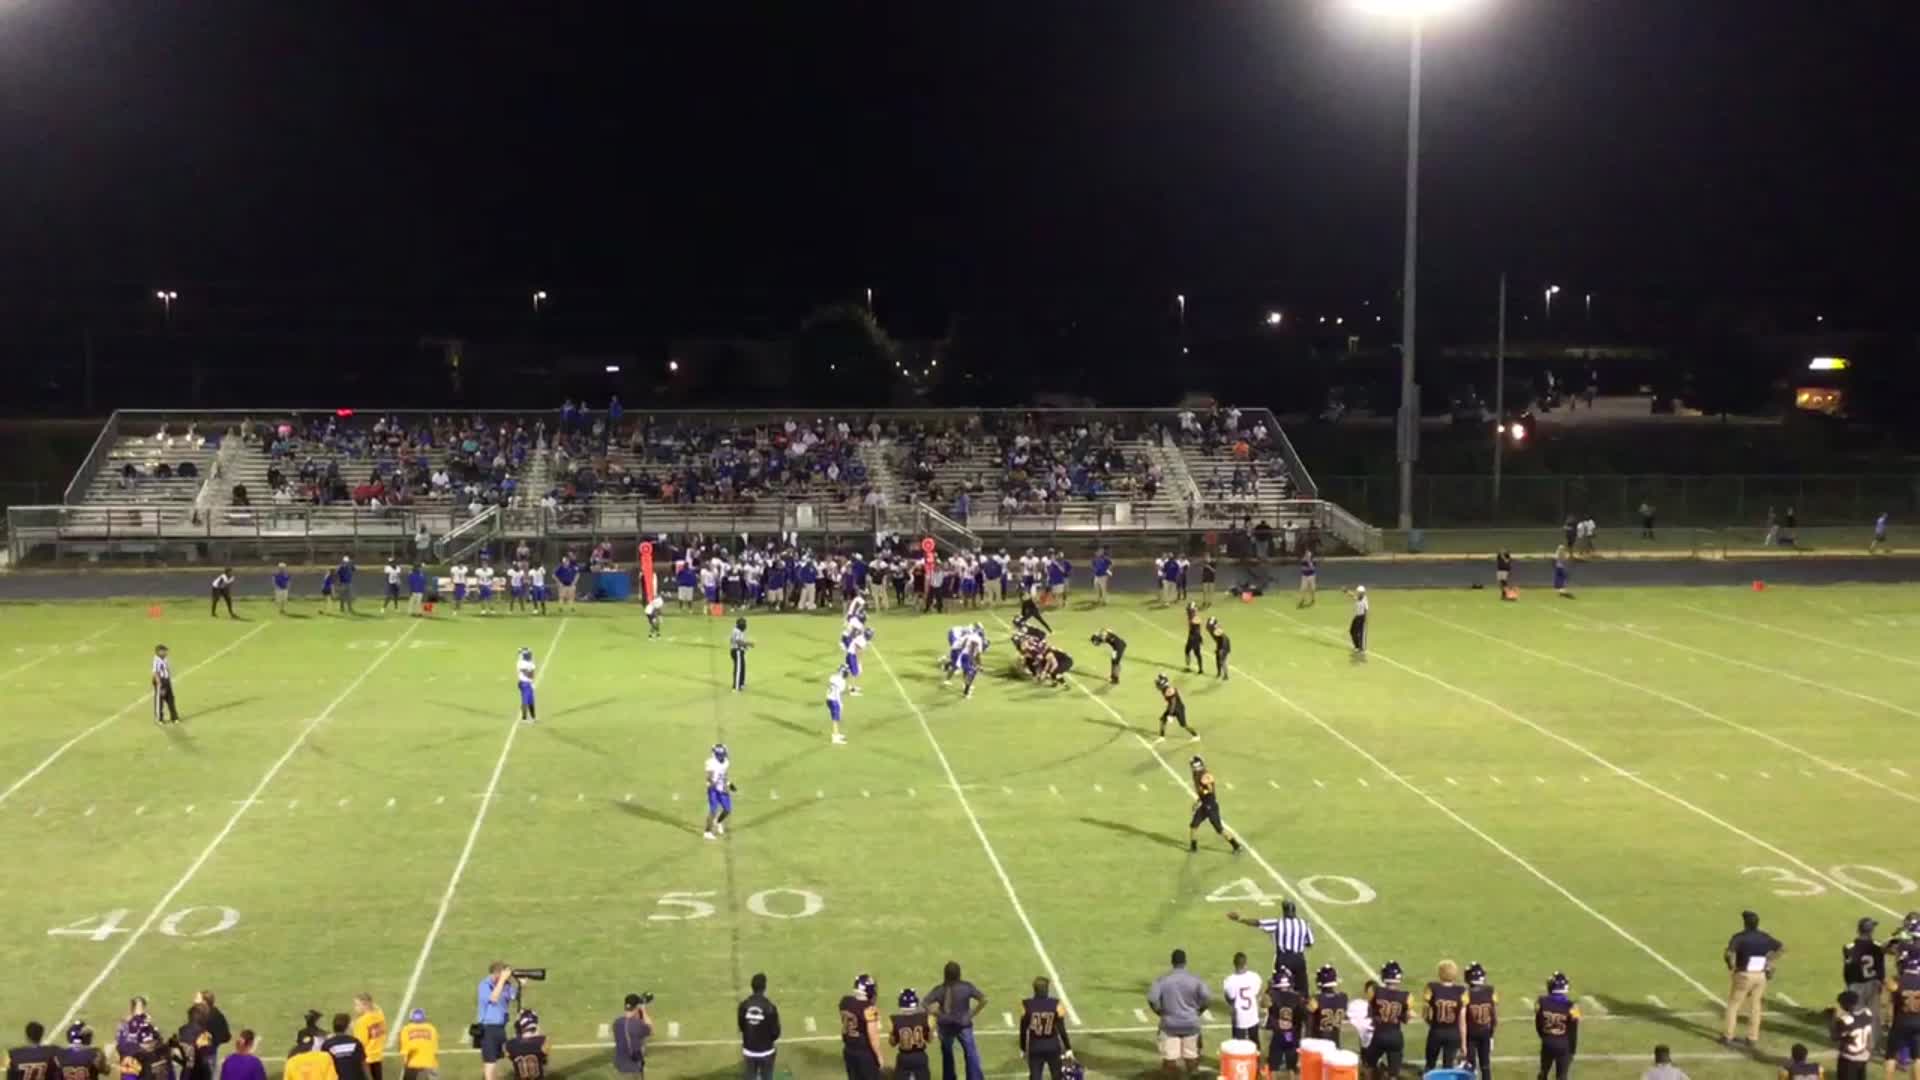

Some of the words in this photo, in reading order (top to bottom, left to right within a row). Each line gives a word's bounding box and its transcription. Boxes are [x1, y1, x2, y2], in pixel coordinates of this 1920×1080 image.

[647, 888, 824, 920] 50
[1205, 875, 1377, 906] 40
[48, 907, 240, 941] 40
[1861, 955, 1876, 978] 2
[1239, 986, 1252, 1010] 5
